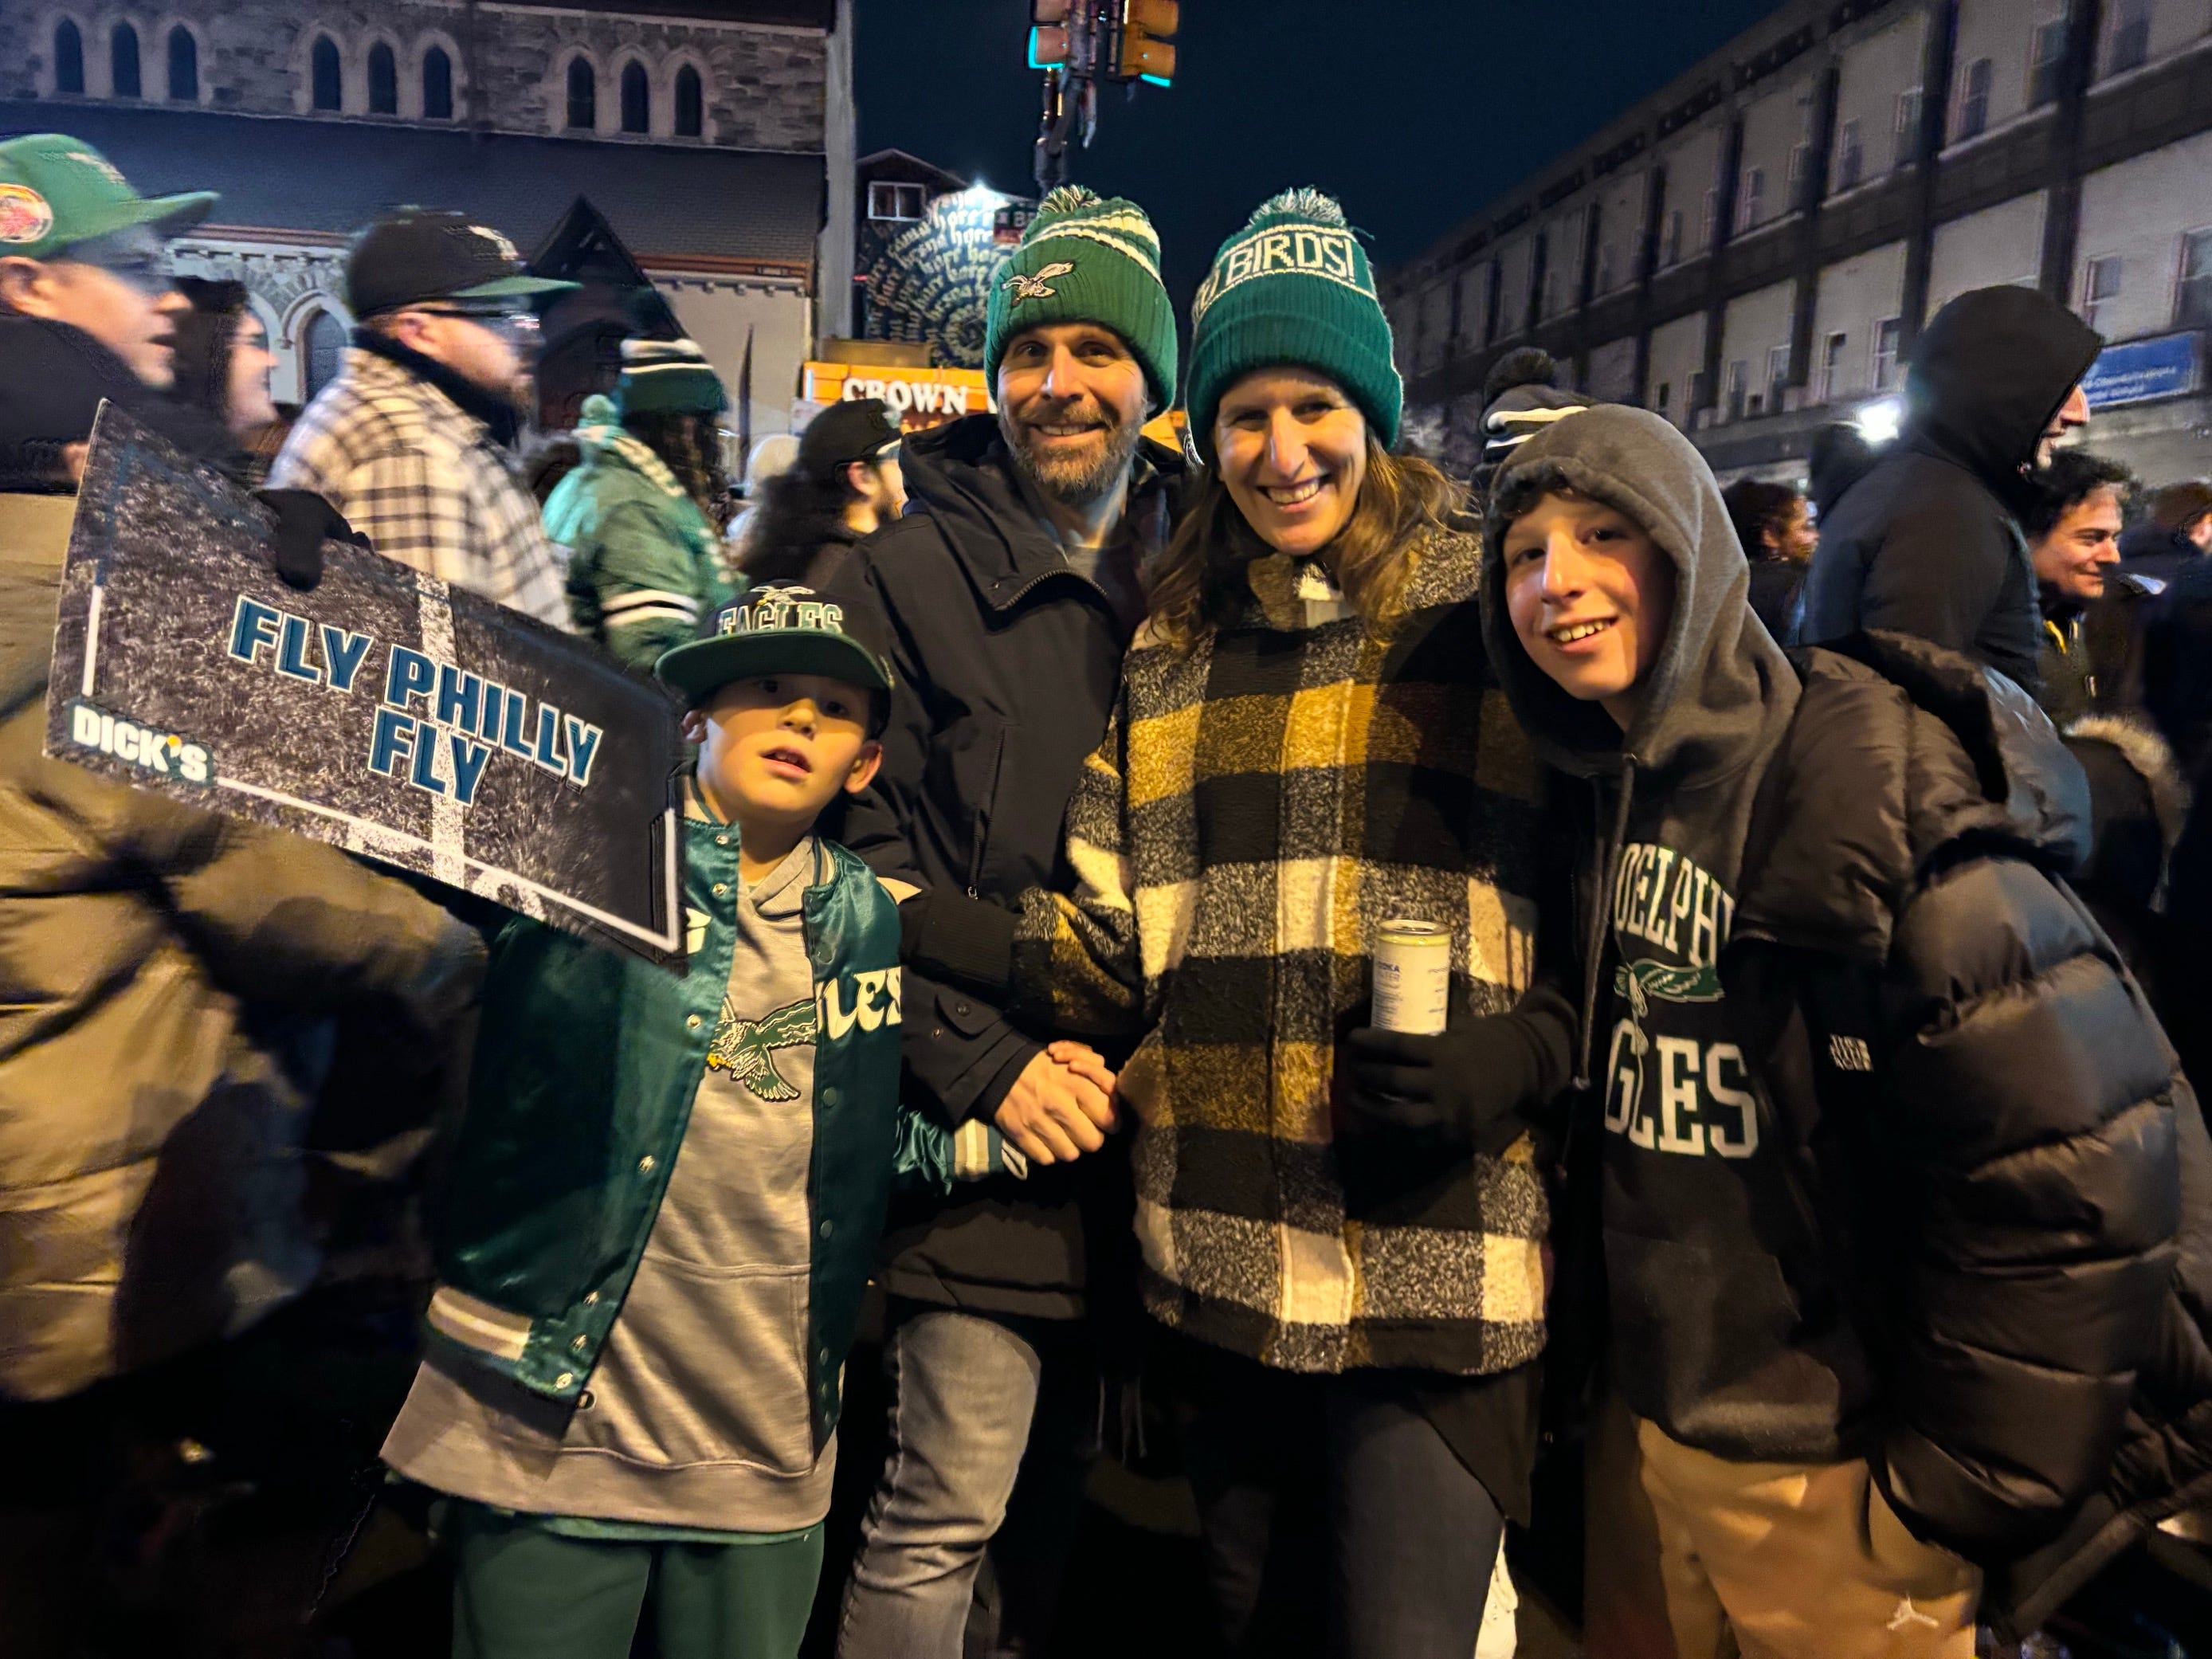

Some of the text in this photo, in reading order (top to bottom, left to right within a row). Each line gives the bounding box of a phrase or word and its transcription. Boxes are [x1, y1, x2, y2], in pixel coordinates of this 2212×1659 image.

[1226, 231, 1356, 287] BIRDS!
[842, 378, 969, 416] CROWN
[718, 601, 843, 637] EAGLES
[228, 594, 604, 787] FLY PHILLY
[73, 705, 208, 782] DICK'S
[367, 705, 492, 808] FLY
